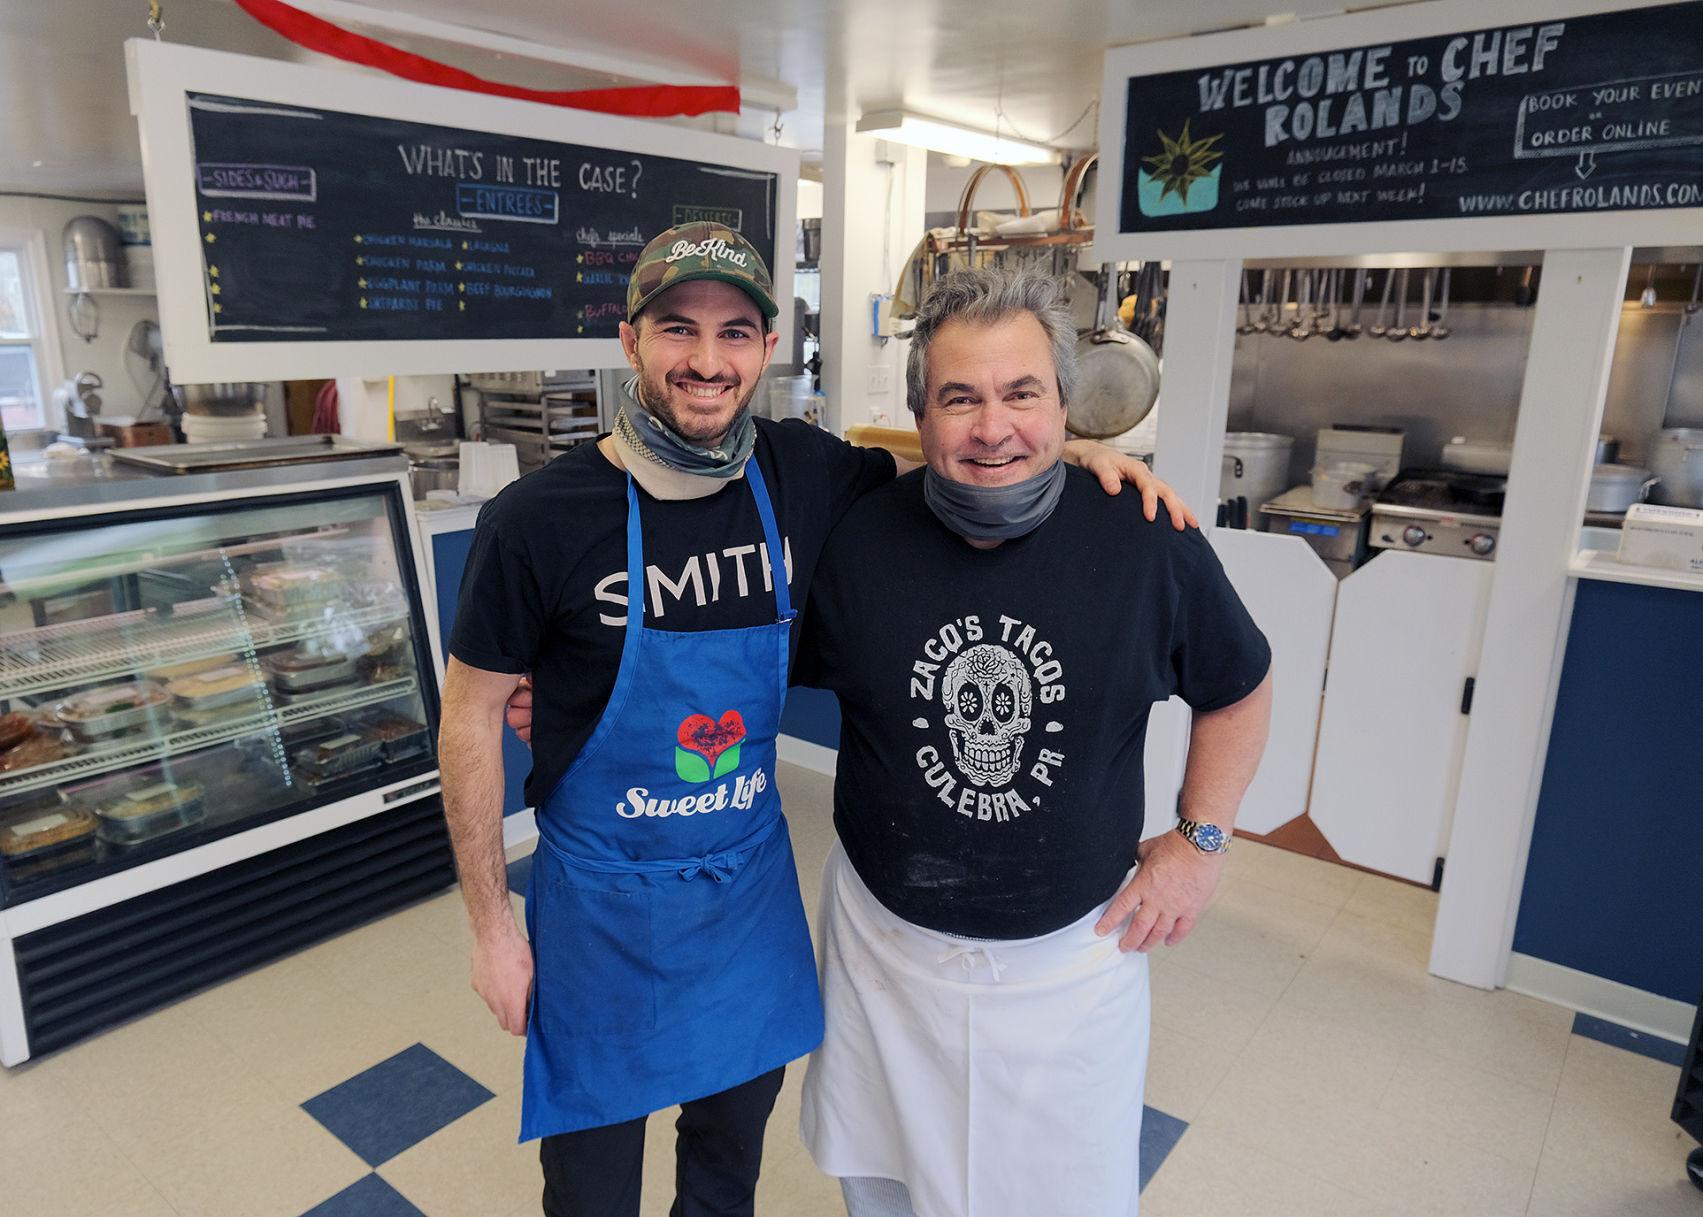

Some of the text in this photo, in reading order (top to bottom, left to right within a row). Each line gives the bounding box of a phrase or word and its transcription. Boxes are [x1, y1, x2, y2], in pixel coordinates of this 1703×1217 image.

[1198, 23, 1565, 113] WELCOME TO CHEF
[1265, 80, 1466, 148] ROLANDS
[1528, 80, 1703, 113] BOOK YOUR EVEN
[1531, 119, 1672, 147] ORDER ONLINE
[398, 145, 643, 199] WHATS IN THE CASE?
[1256, 176, 1285, 191] WILL
[1292, 171, 1310, 187] BE
[1318, 167, 1366, 184] CLOSED
[1373, 160, 1424, 179] MARCH
[1235, 182, 1426, 212] COME STOCK UP NEXT WEEK!
[584, 251, 614, 266] BBQ
[910, 614, 1066, 704] ZACO'S TACOS
[1030, 748, 1066, 787] PR
[615, 767, 768, 819] Sweet Life
